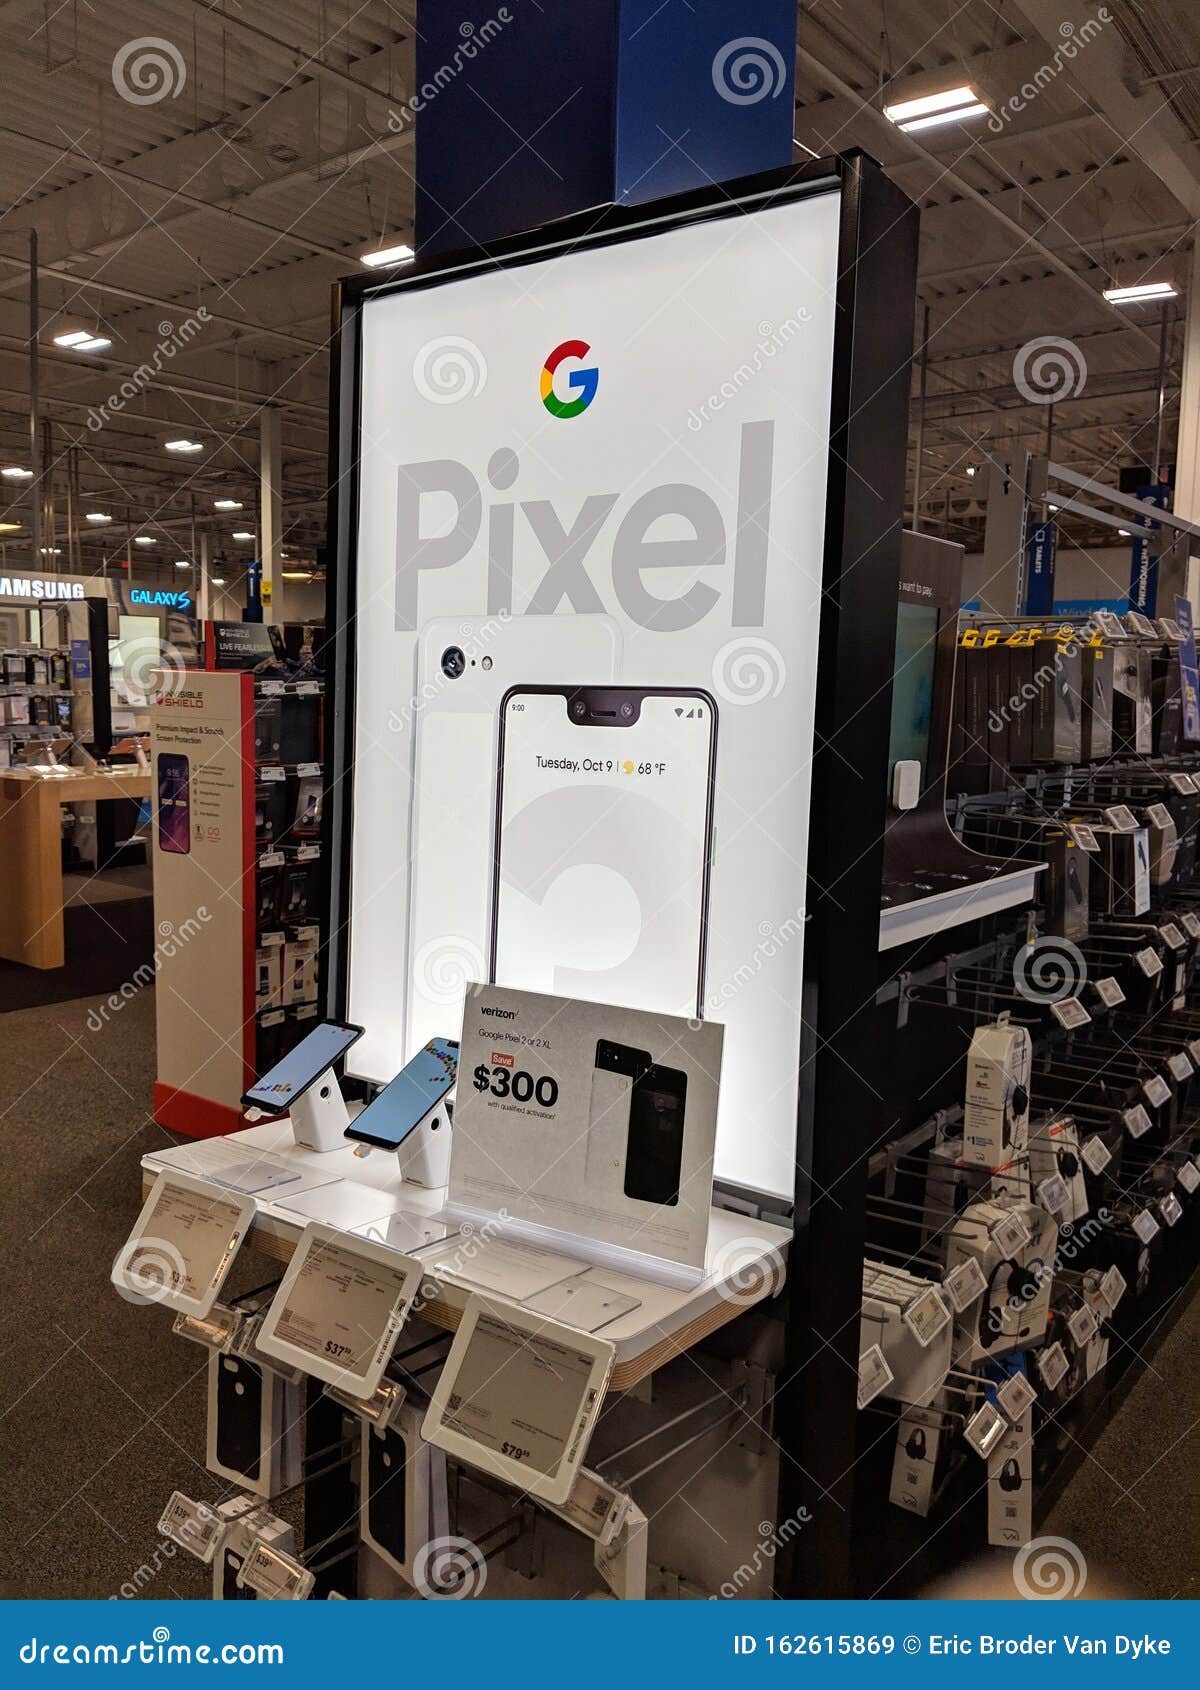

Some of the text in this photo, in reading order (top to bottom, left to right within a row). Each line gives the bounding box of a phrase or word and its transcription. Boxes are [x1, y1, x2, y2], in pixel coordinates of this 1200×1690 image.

[394, 419, 775, 633] Pixel
[1138, 547, 1149, 607] NETWORKING
[165, 698, 204, 708] SHIELD
[512, 703, 525, 712] 9:00
[536, 756, 580, 772] Tuesday,
[582, 758, 604, 772] Oct
[606, 760, 613, 773] 9
[638, 762, 652, 774] 68
[481, 1006, 516, 1020] verizon
[478, 1028, 504, 1041] Google
[505, 1031, 521, 1043] Pixel
[542, 1040, 552, 1049] XL
[492, 1054, 513, 1066] Save
[473, 1063, 559, 1108] $300
[487, 1100, 500, 1109] with
[500, 1102, 525, 1114] qualified
